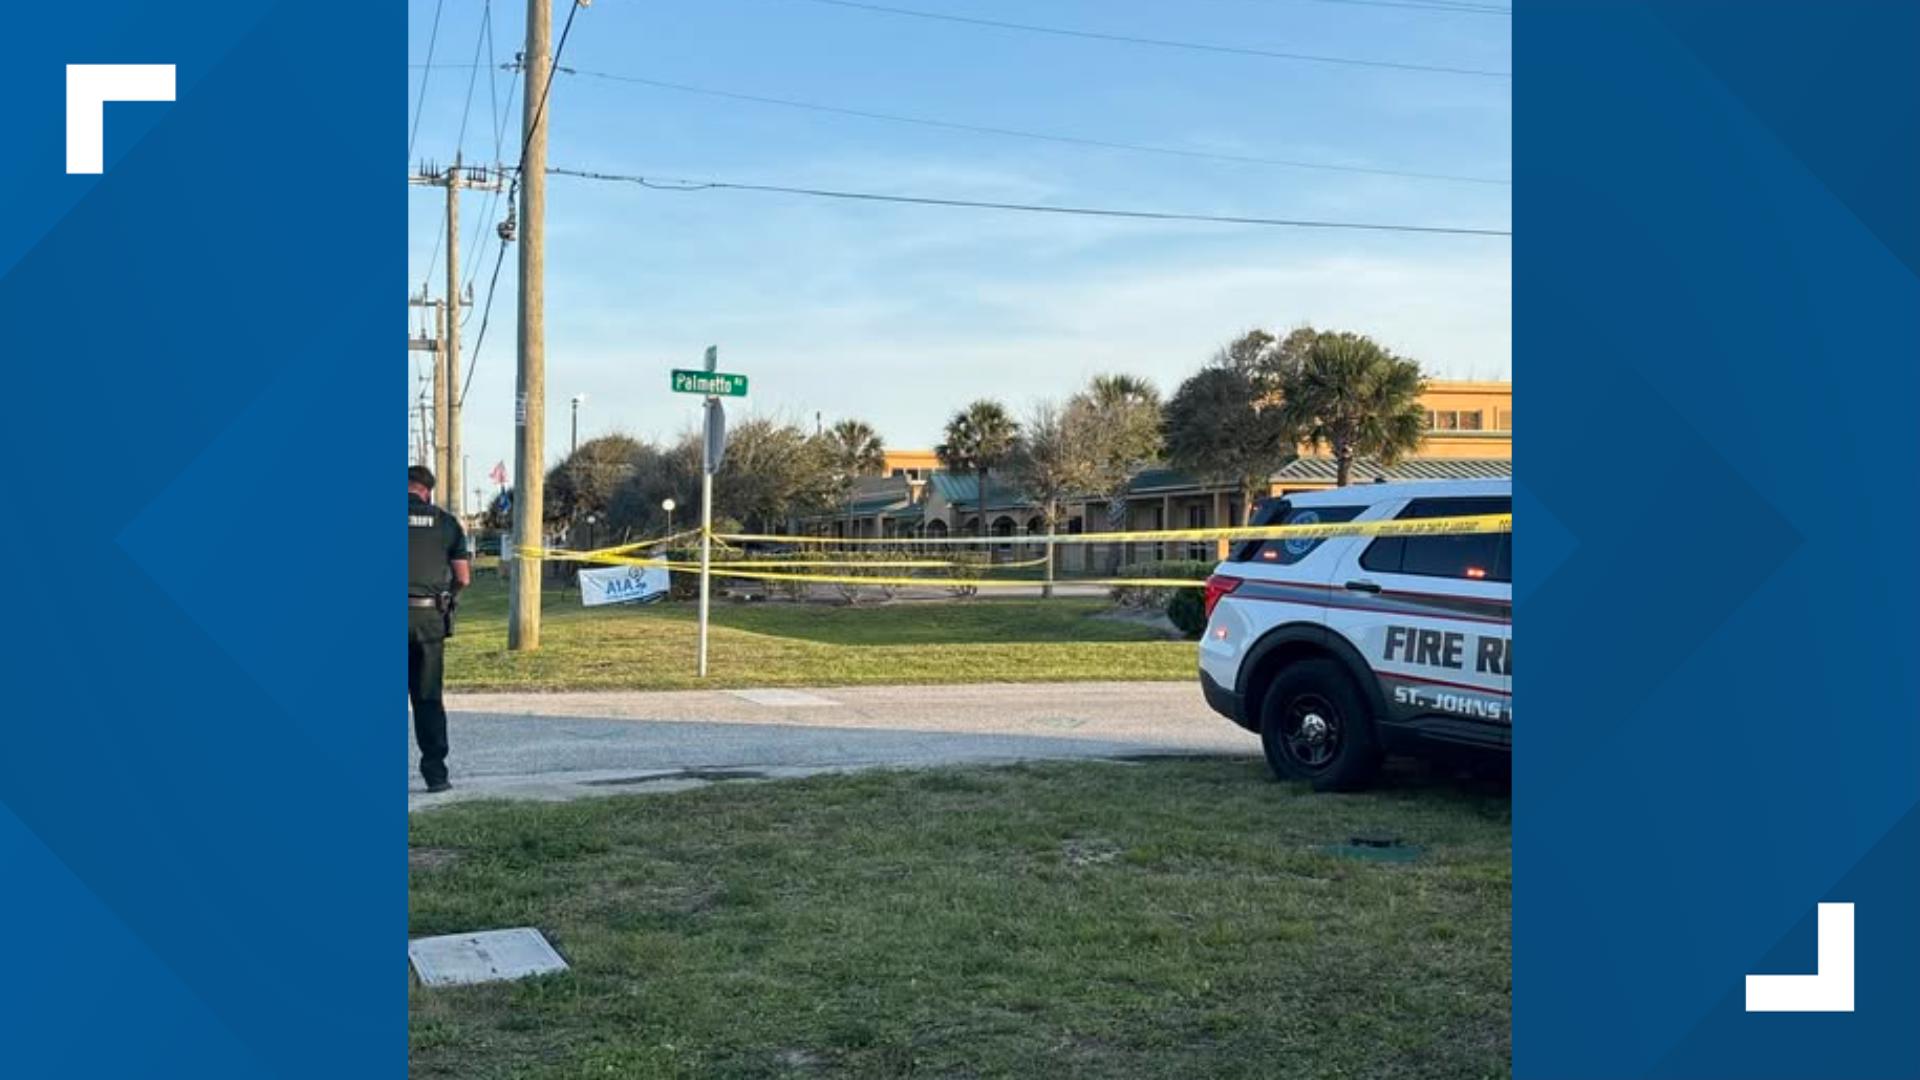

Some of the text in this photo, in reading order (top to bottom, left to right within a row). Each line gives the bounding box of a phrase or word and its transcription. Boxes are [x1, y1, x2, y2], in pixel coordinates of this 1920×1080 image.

[676, 373, 731, 393] Palmetto
[1383, 625, 1464, 669] FIRE
[1395, 686, 1424, 706] ST.
[1431, 694, 1501, 719] JOHNS
